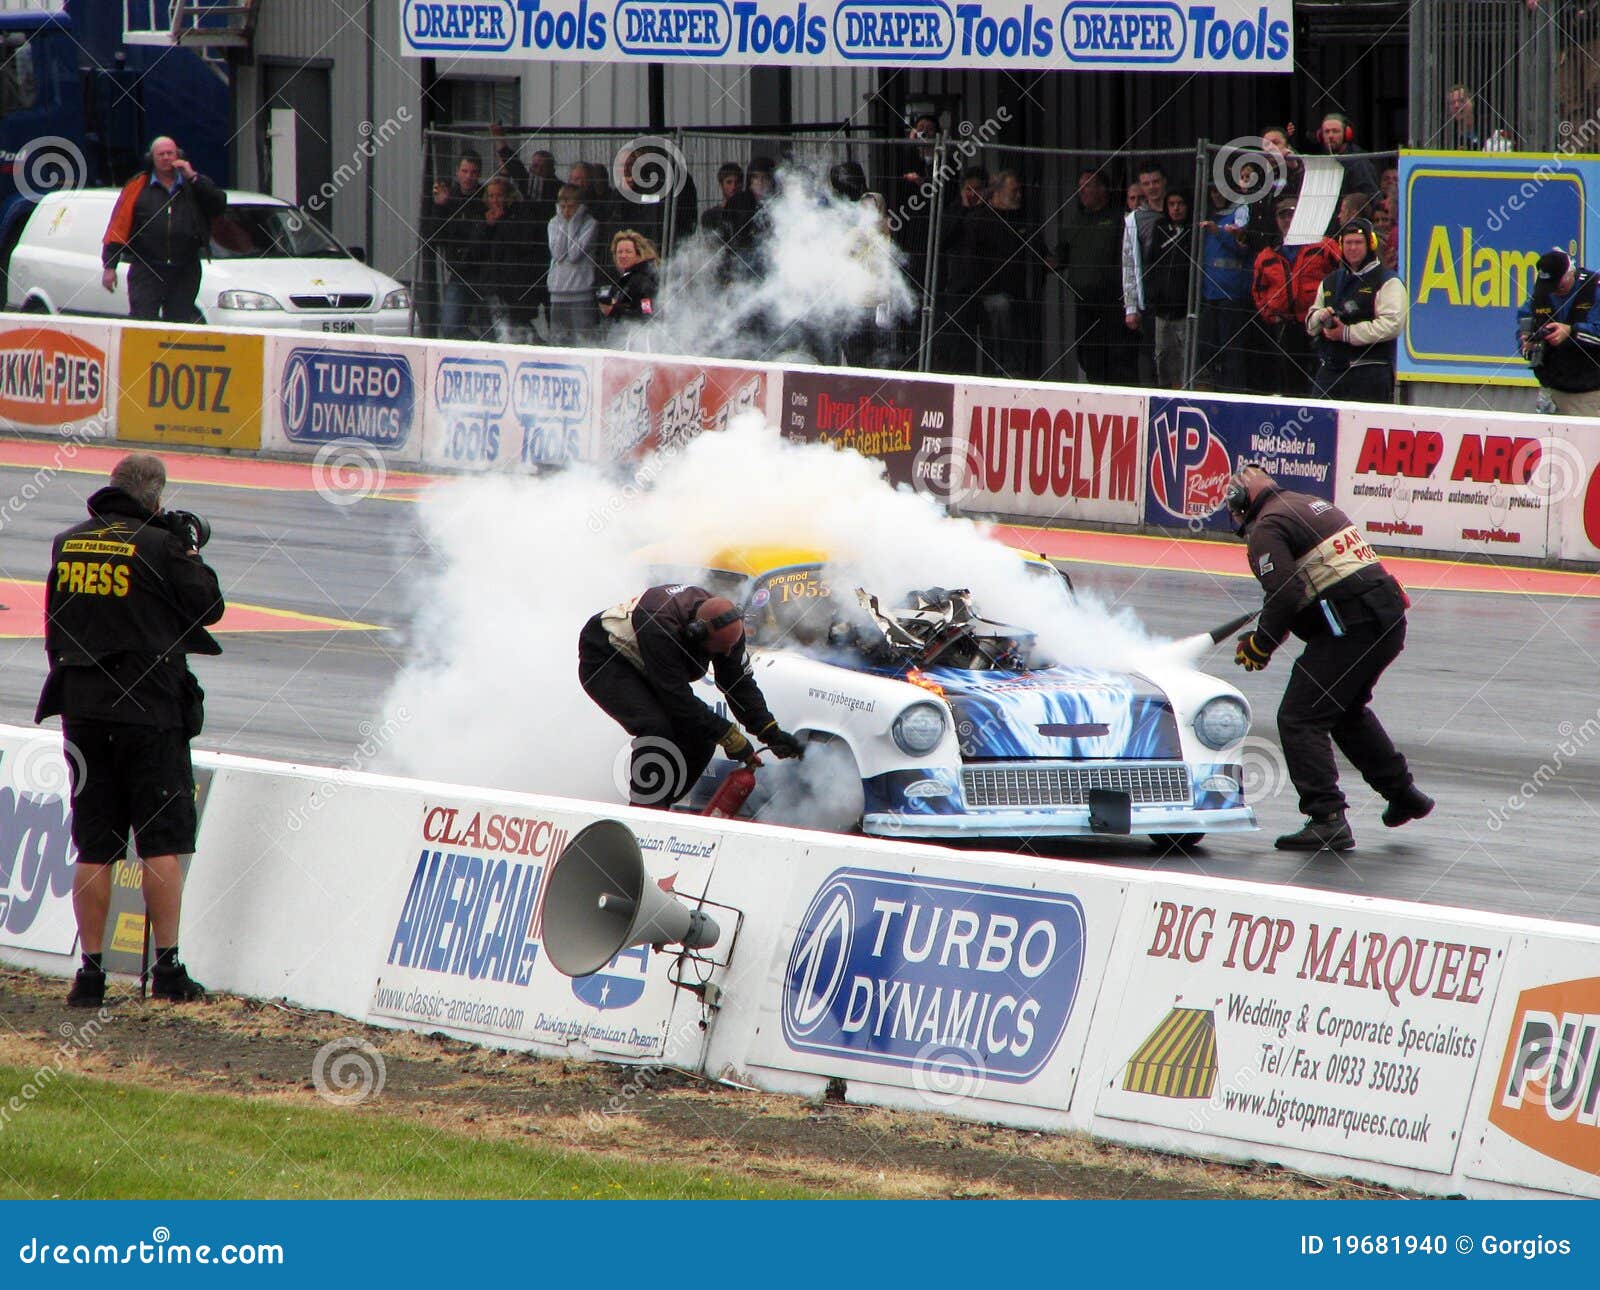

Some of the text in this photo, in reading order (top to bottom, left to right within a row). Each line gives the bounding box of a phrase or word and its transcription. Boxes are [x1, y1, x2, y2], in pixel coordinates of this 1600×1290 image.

[415, 0, 1289, 60] DRAPER Tools DRAPER Tools DRAPER Tools DRAPER Tools
[1417, 226, 1540, 309] Alam
[149, 361, 232, 413] DOTZ
[315, 363, 401, 399] TURBO
[442, 370, 582, 412] DRAPER DRAPER
[311, 402, 400, 439] DYNAMICS
[920, 410, 945, 429] AND
[921, 436, 943, 454] IT'S
[966, 406, 1139, 502] AUTOGLYM
[1155, 407, 1211, 512] VP
[1251, 434, 1316, 456] World Leader in
[1356, 427, 1543, 485] ARP ARP
[917, 461, 945, 480] FREE
[1188, 472, 1229, 499] Racing
[1261, 456, 1279, 475] Fuel
[1280, 458, 1328, 482] Technology
[1187, 503, 1215, 514] FUELS
[1353, 483, 1392, 498] automotive
[1411, 487, 1444, 503] products
[1448, 490, 1489, 506] automotive
[1508, 495, 1542, 511] products
[57, 561, 131, 597] PRESS
[768, 571, 809, 590] pro mod
[780, 580, 833, 604] 1955
[808, 687, 876, 713] www.rijsbergen.nl
[423, 806, 554, 858] CLASSIC
[665, 836, 713, 862] Magazine
[387, 849, 543, 985] AMERICAN
[871, 896, 1057, 978] TURBO
[1147, 900, 1492, 1008] BIG TOP MARQUEE
[376, 986, 525, 1031] www.classic-american.com
[842, 975, 1042, 1058] DYNAMICS
[1227, 993, 1478, 1060] Wedding & Corporate Specialists
[534, 1012, 661, 1049] Driving the American Dream
[1325, 1052, 1365, 1088] 01933
[1368, 1059, 1421, 1097] 350336
[1224, 1086, 1433, 1144] www.bigtopmarquees.co.uk
